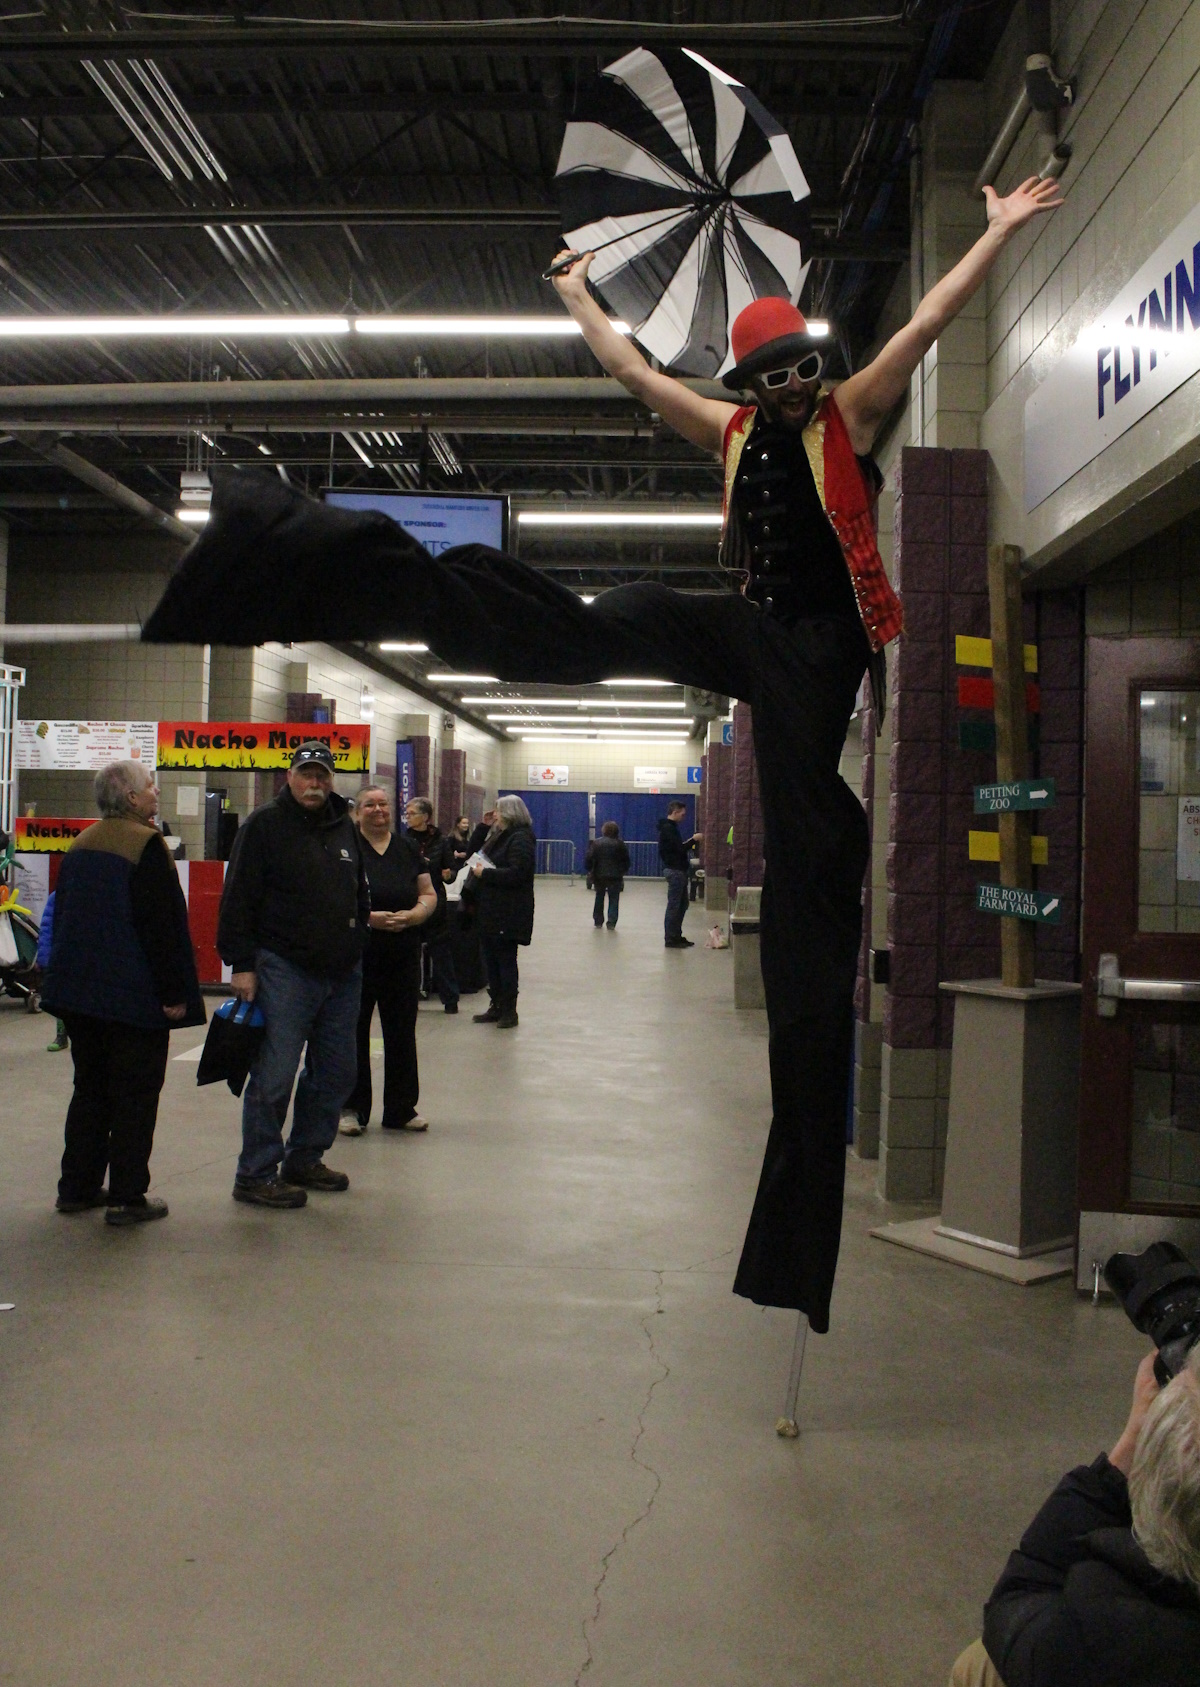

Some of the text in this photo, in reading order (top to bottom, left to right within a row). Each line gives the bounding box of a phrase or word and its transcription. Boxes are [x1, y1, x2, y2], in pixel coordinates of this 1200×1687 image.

[173, 729, 258, 750] Nacho
[979, 784, 1020, 799] PETTING
[989, 798, 1010, 810] ZOO
[26, 823, 80, 838] Nacho
[980, 885, 1036, 905] THE ROYAL
[979, 896, 1038, 916] FARM YARD
